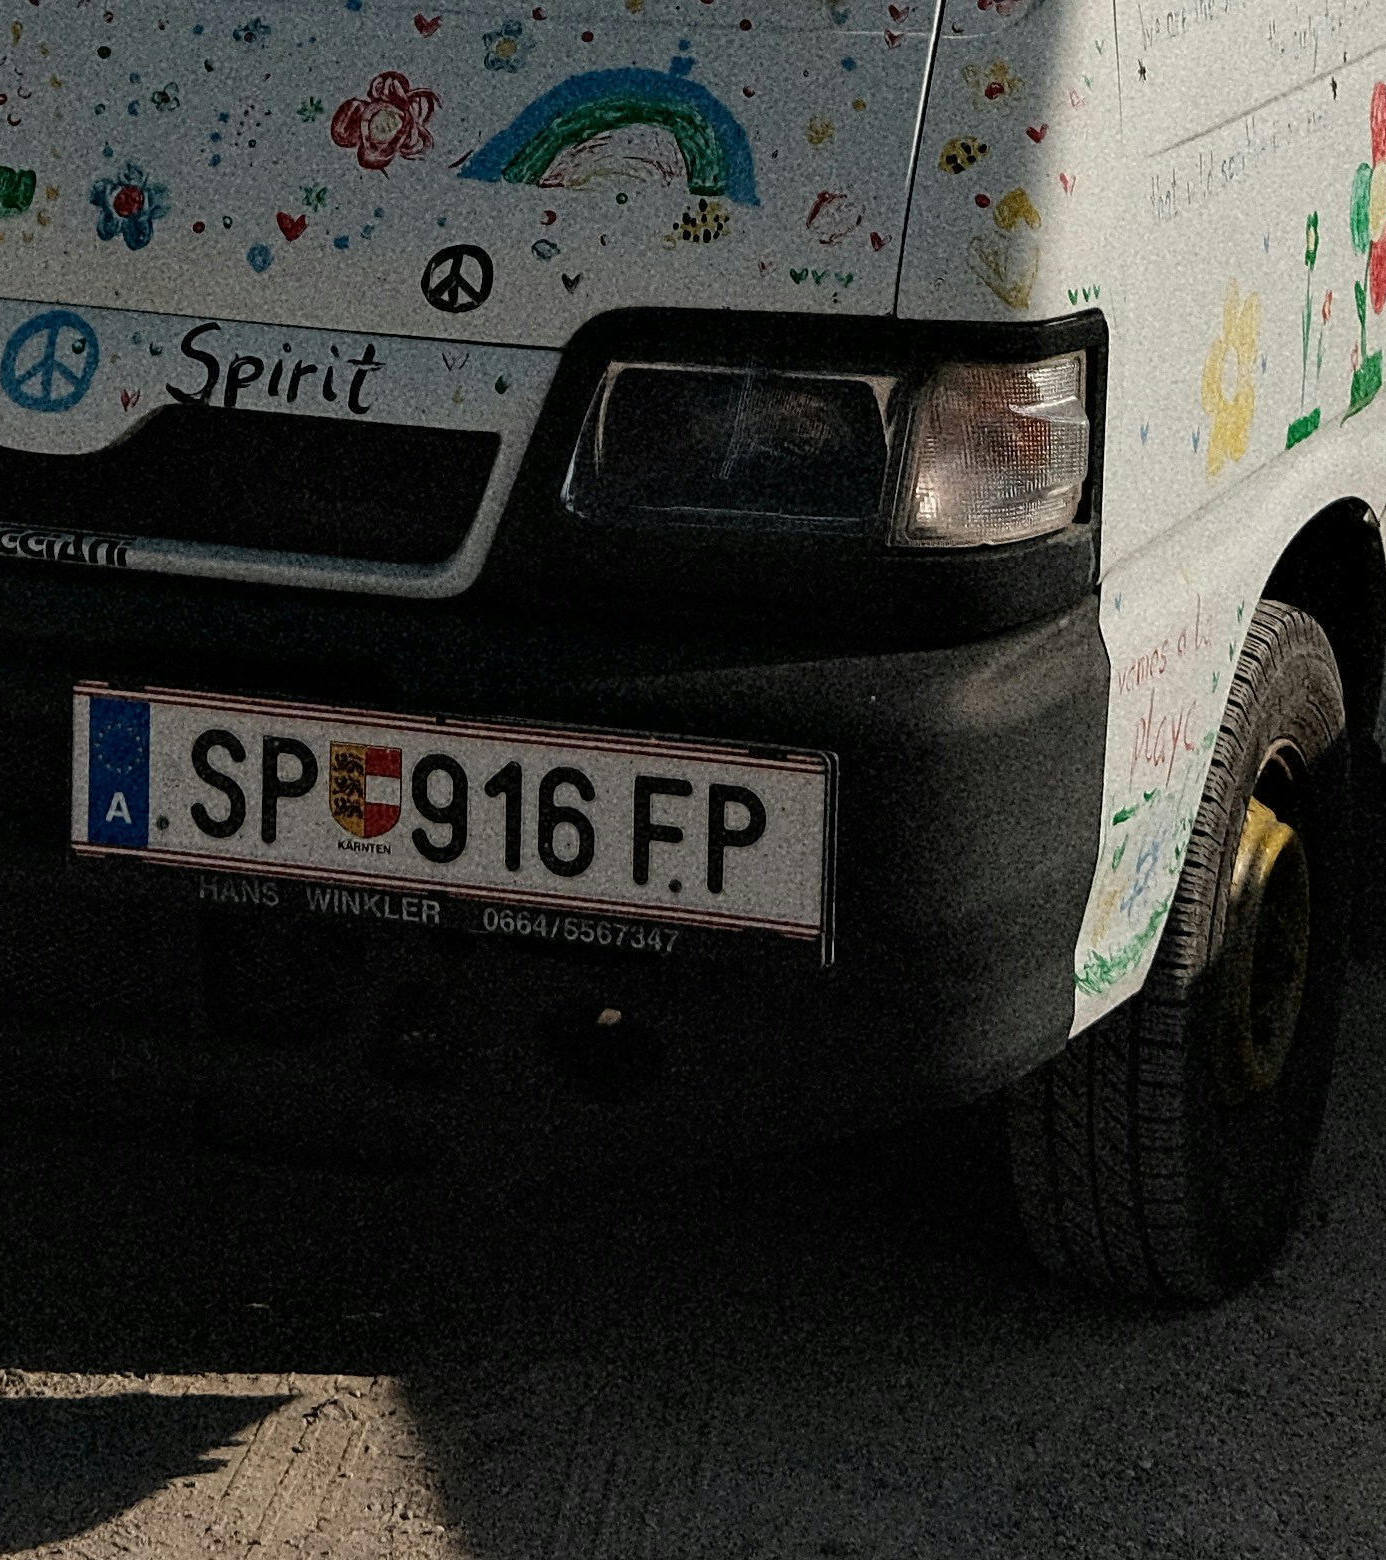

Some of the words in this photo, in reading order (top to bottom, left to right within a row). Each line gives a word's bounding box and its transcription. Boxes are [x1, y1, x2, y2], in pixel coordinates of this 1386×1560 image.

[165, 320, 385, 416] Spirit
[105, 791, 132, 826] A
[189, 728, 318, 845] SP
[411, 752, 597, 878] 916
[632, 774, 768, 896] FP
[337, 837, 392, 856] KÄRNTEN
[198, 874, 280, 908] HANS
[304, 884, 442, 926] WINKLER
